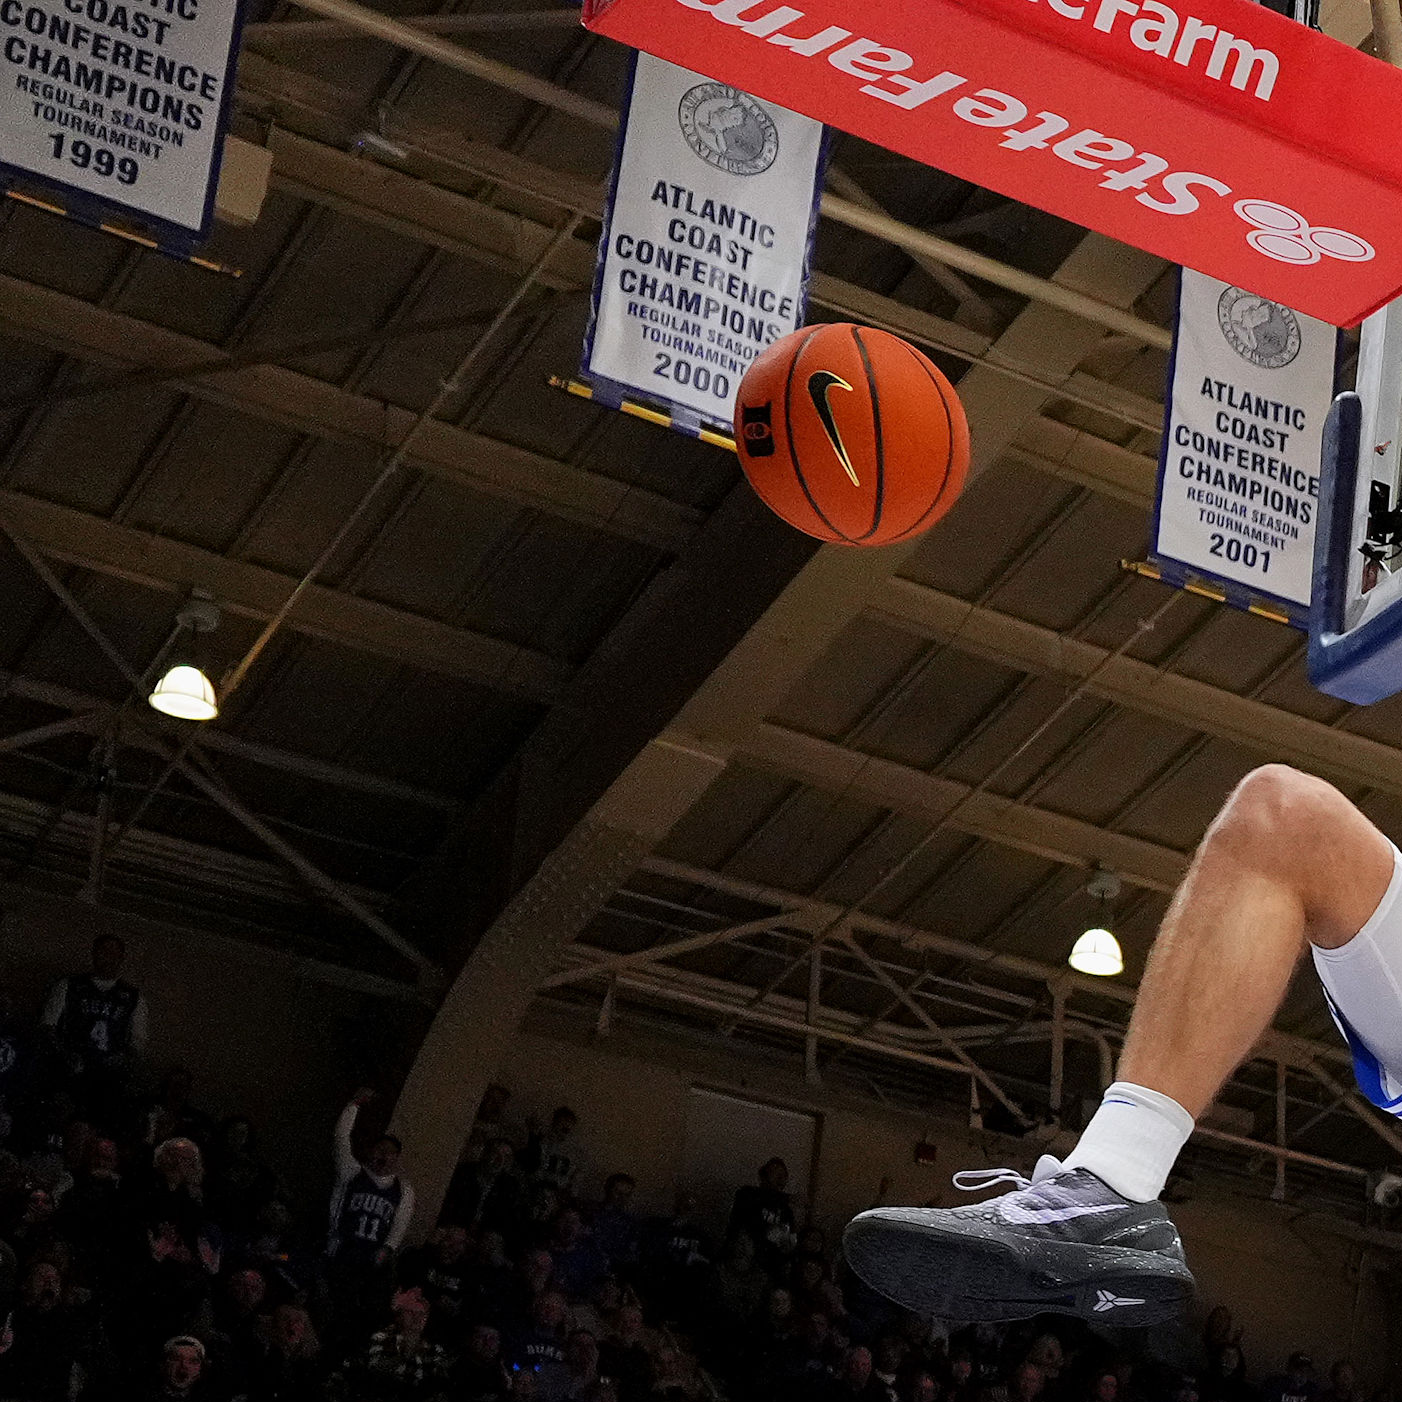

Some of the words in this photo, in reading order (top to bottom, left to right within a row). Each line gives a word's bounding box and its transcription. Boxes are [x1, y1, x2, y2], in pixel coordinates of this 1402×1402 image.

[0, 0, 218, 101] CONFERENCE
[4, 36, 204, 130] CHAMPIONS
[16, 74, 104, 118] REGULAR
[111, 109, 184, 147] SEASON
[33, 100, 163, 160] TOURNAMENT
[49, 133, 139, 185] 1999
[651, 180, 775, 248] ATLANTIC
[668, 218, 753, 271] COAST
[615, 233, 793, 320] CONFERENCE
[619, 269, 782, 345] CHAMPIONS
[627, 301, 700, 338] REGULAR
[640, 324, 747, 376] TOURNAMENT
[653, 352, 729, 399] 2000
[1200, 376, 1306, 431] ATLANTIC
[1215, 410, 1290, 454] COAST
[1174, 424, 1320, 498] CONFERENCE
[1178, 455, 1313, 525] CHAMPIONS
[1186, 486, 1248, 519] REGULAR
[1251, 509, 1299, 540] SEASON
[1199, 508, 1287, 551] TOURNAMENT
[1209, 533, 1272, 573] 2001
